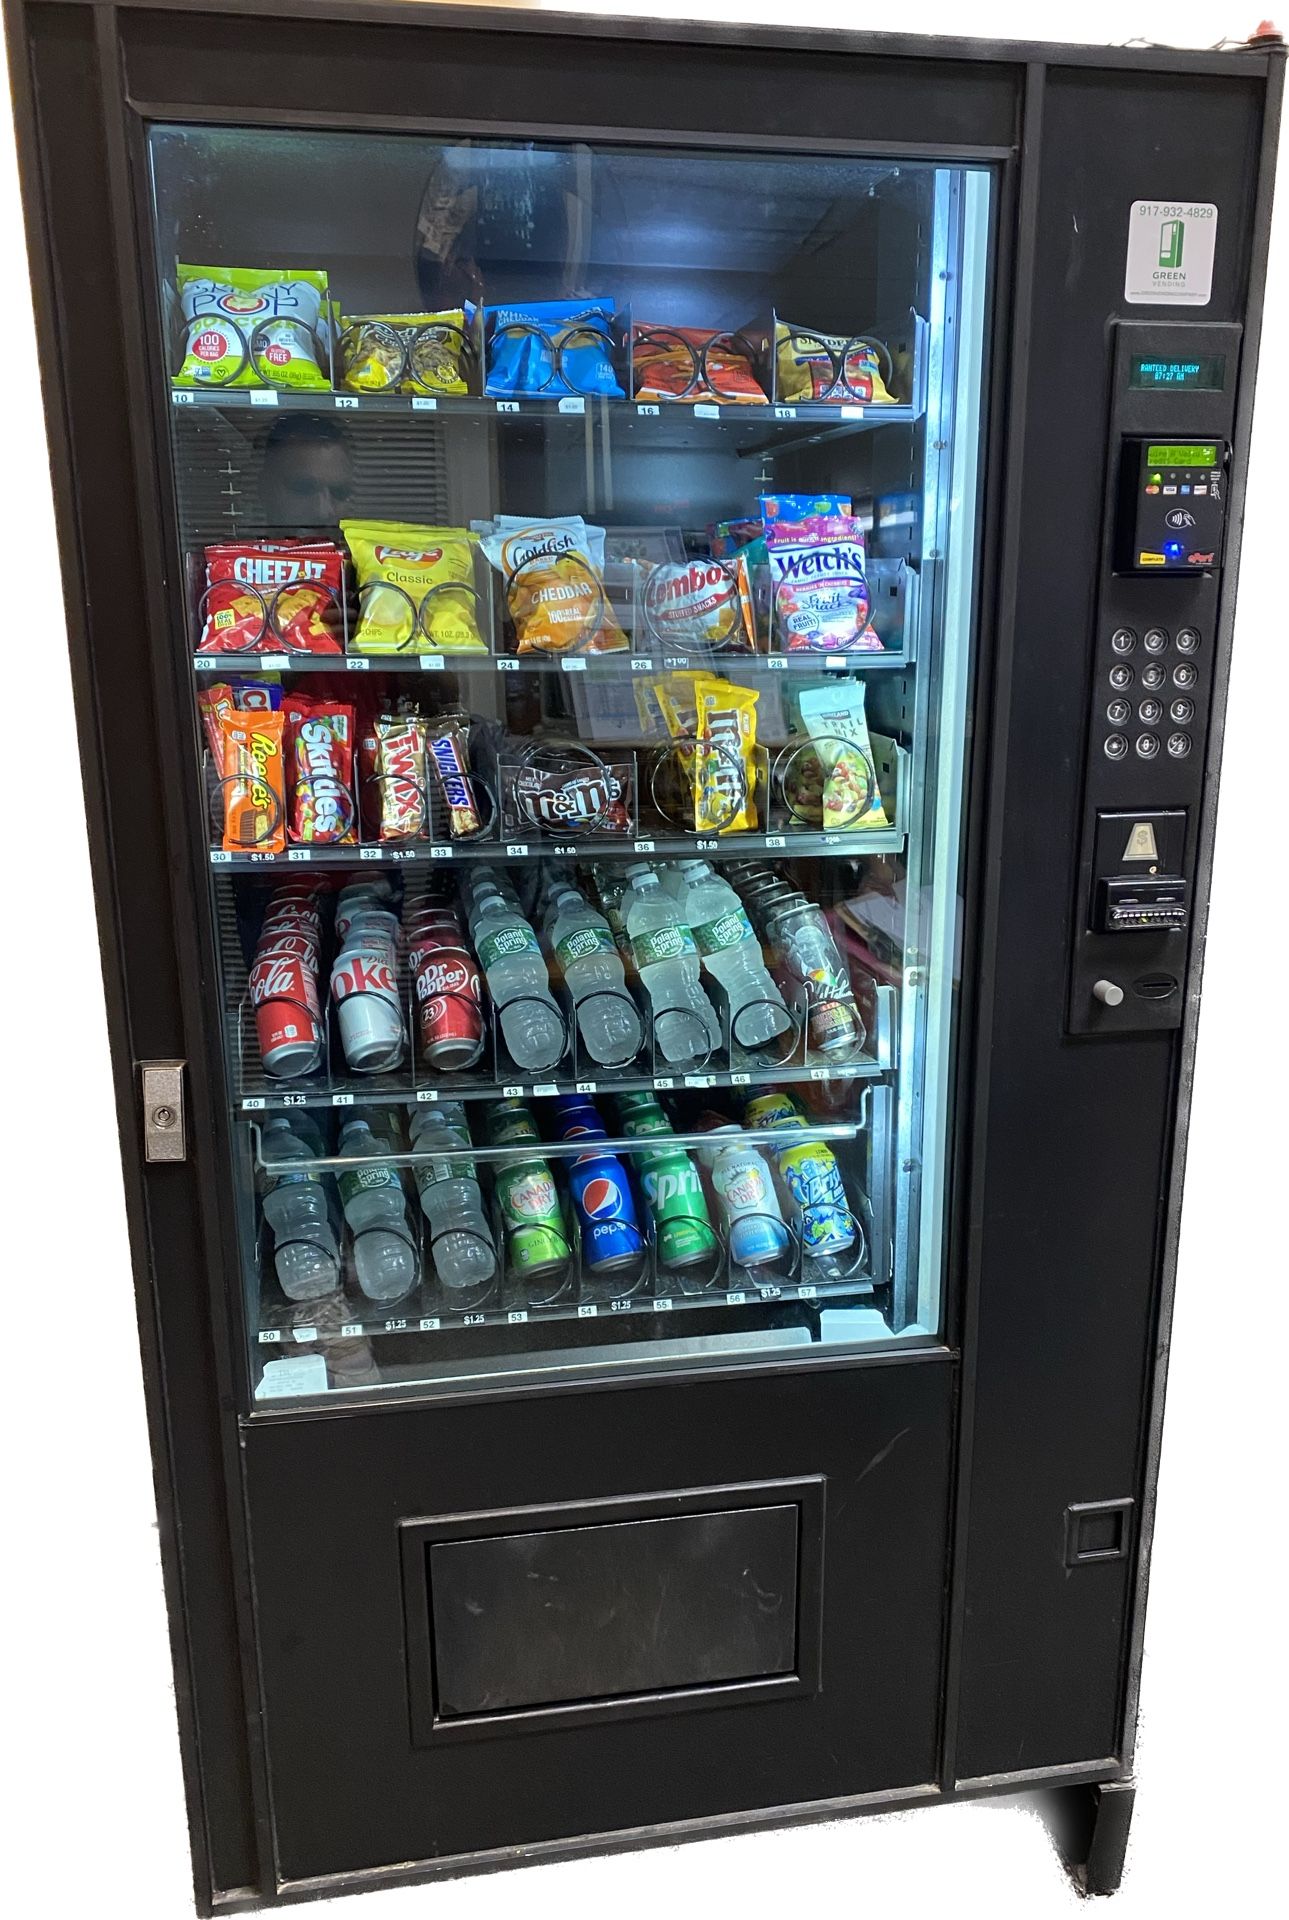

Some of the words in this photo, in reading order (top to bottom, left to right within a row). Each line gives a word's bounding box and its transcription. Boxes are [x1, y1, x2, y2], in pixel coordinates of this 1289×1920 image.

[1139, 205, 1213, 218] 917-932-4829
[1152, 271, 1187, 280] GREEN
[1152, 280, 1186, 288] VENDING
[199, 334, 220, 346] 100
[269, 352, 288, 362] FREE
[1170, 364, 1199, 373] DELIVERY
[174, 394, 188, 402] 10
[500, 404, 513, 412] 14
[641, 407, 654, 415] 16
[773, 536, 790, 544] Fruit
[774, 547, 862, 579] Welch's
[386, 571, 433, 585] Classic
[531, 582, 593, 605] CHEDDAR
[693, 595, 717, 614] SNACKS
[792, 614, 811, 624] REAL
[793, 618, 817, 631] FRUIT!
[197, 660, 210, 668] 20
[350, 661, 363, 669] 22
[770, 660, 783, 668] 28
[822, 719, 864, 729] TRAIL
[834, 728, 858, 738] MIX
[301, 722, 340, 832] Skittles
[386, 728, 421, 817] TWIX
[431, 739, 470, 807] SNICKERS
[637, 843, 650, 851] 36
[696, 840, 718, 849] $1.50
[292, 851, 305, 860] 31
[363, 850, 377, 858] 32
[393, 850, 415, 859] $1.50
[434, 849, 447, 857] 33
[510, 847, 523, 855] 34
[212, 853, 226, 861] 30
[251, 853, 275, 862] $1.50
[711, 913, 739, 936] Poland
[493, 928, 524, 947] Poland
[566, 928, 597, 948] Poland
[649, 927, 681, 948] Poland
[715, 922, 745, 946] Spring
[497, 936, 528, 954] Spring
[570, 937, 600, 959] Spring
[653, 936, 684, 957] Spring
[424, 963, 448, 982] Dr
[331, 957, 398, 1003] oke
[424, 1007, 435, 1021] 23
[813, 1070, 824, 1078] 47
[579, 1084, 591, 1092] 44
[656, 1080, 668, 1088] 45
[506, 1088, 518, 1096] 43
[246, 1100, 260, 1108] 40
[283, 1096, 307, 1106] $1.25
[336, 1096, 348, 1104] 41
[360, 1169, 390, 1188] Spring
[644, 1161, 703, 1210] Spri
[528, 1192, 551, 1210] DRY
[761, 1287, 781, 1299] $1.25
[801, 1288, 811, 1296] 57
[729, 1295, 741, 1303] 56
[611, 1300, 632, 1311] $1.25
[656, 1301, 668, 1309] 55
[581, 1308, 592, 1316] 54
[463, 1314, 485, 1325] $1.25
[511, 1314, 522, 1322] 53
[385, 1319, 407, 1331] $1.25
[423, 1321, 435, 1329] 52
[345, 1327, 356, 1335] 51
[262, 1332, 275, 1341] 50
